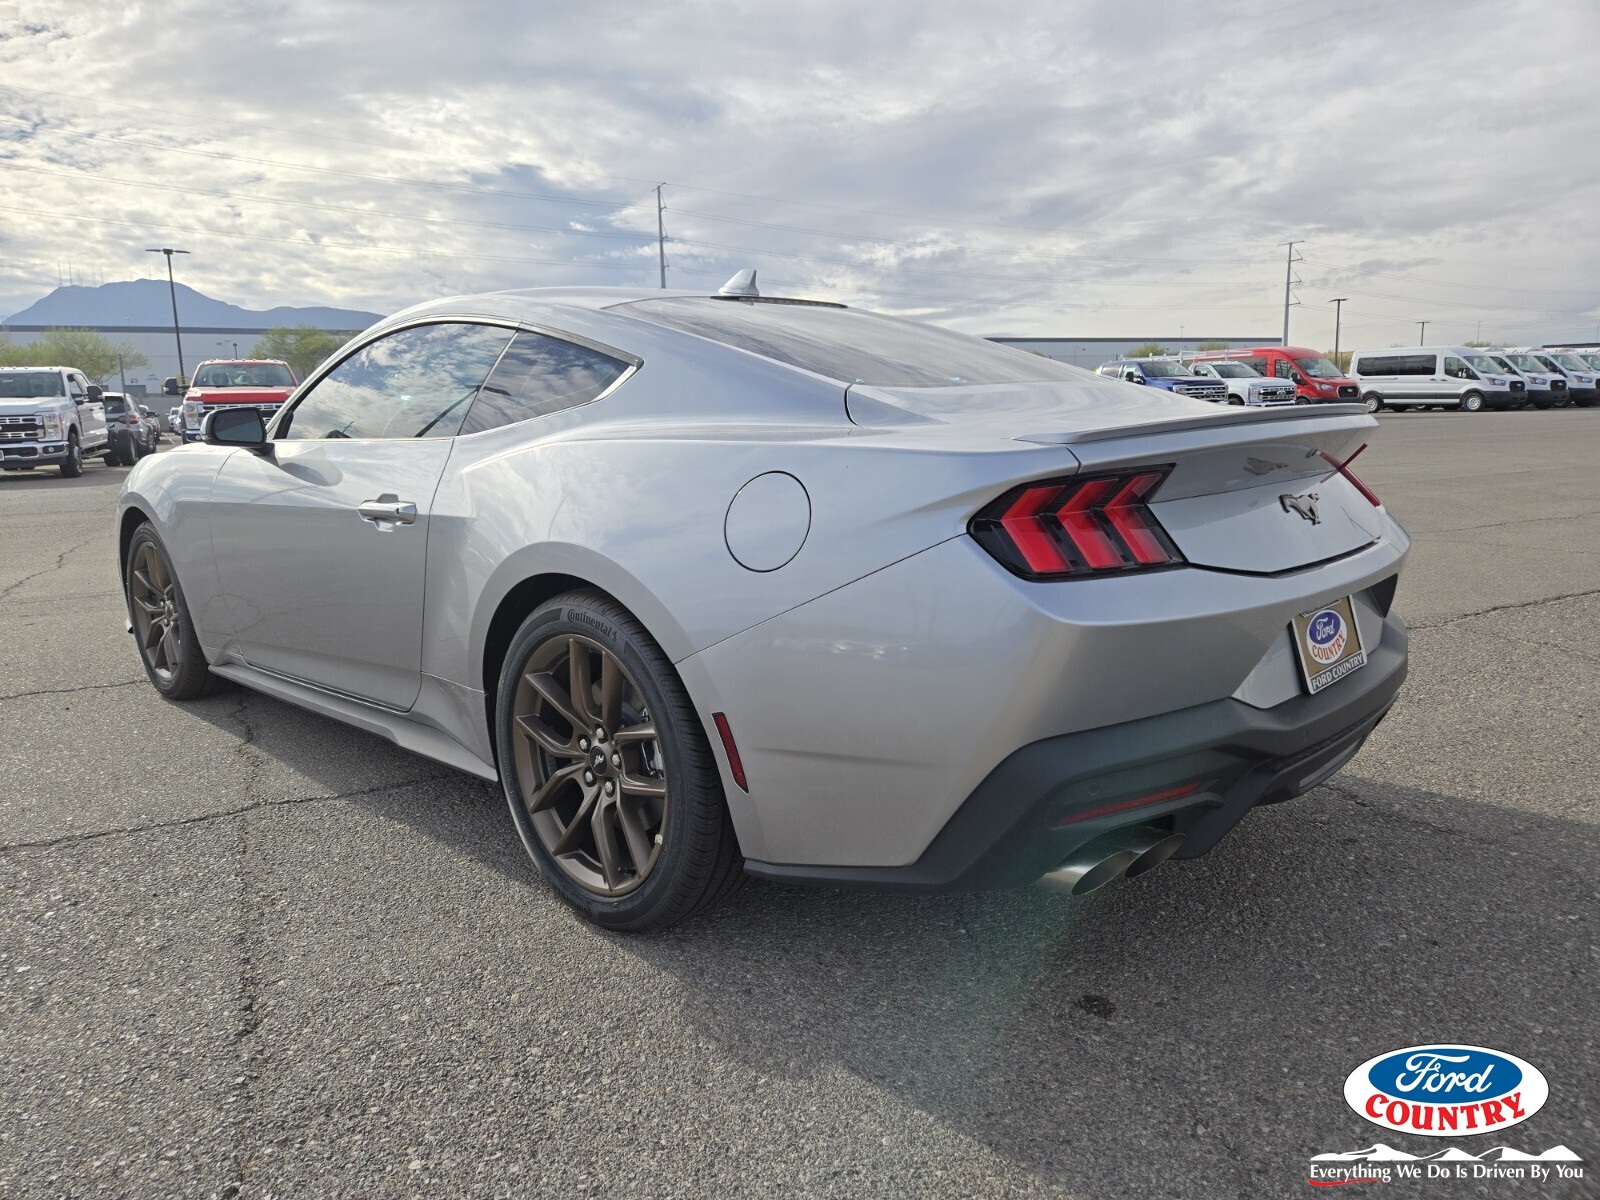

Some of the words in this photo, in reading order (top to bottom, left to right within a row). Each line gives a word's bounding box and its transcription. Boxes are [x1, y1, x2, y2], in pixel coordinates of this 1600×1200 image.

[567, 609, 612, 638] Continental
[1316, 617, 1335, 641] Ford
[1312, 630, 1345, 660] COUNTRY
[1312, 673, 1332, 690] FORD
[1332, 653, 1364, 678] COUNTRY
